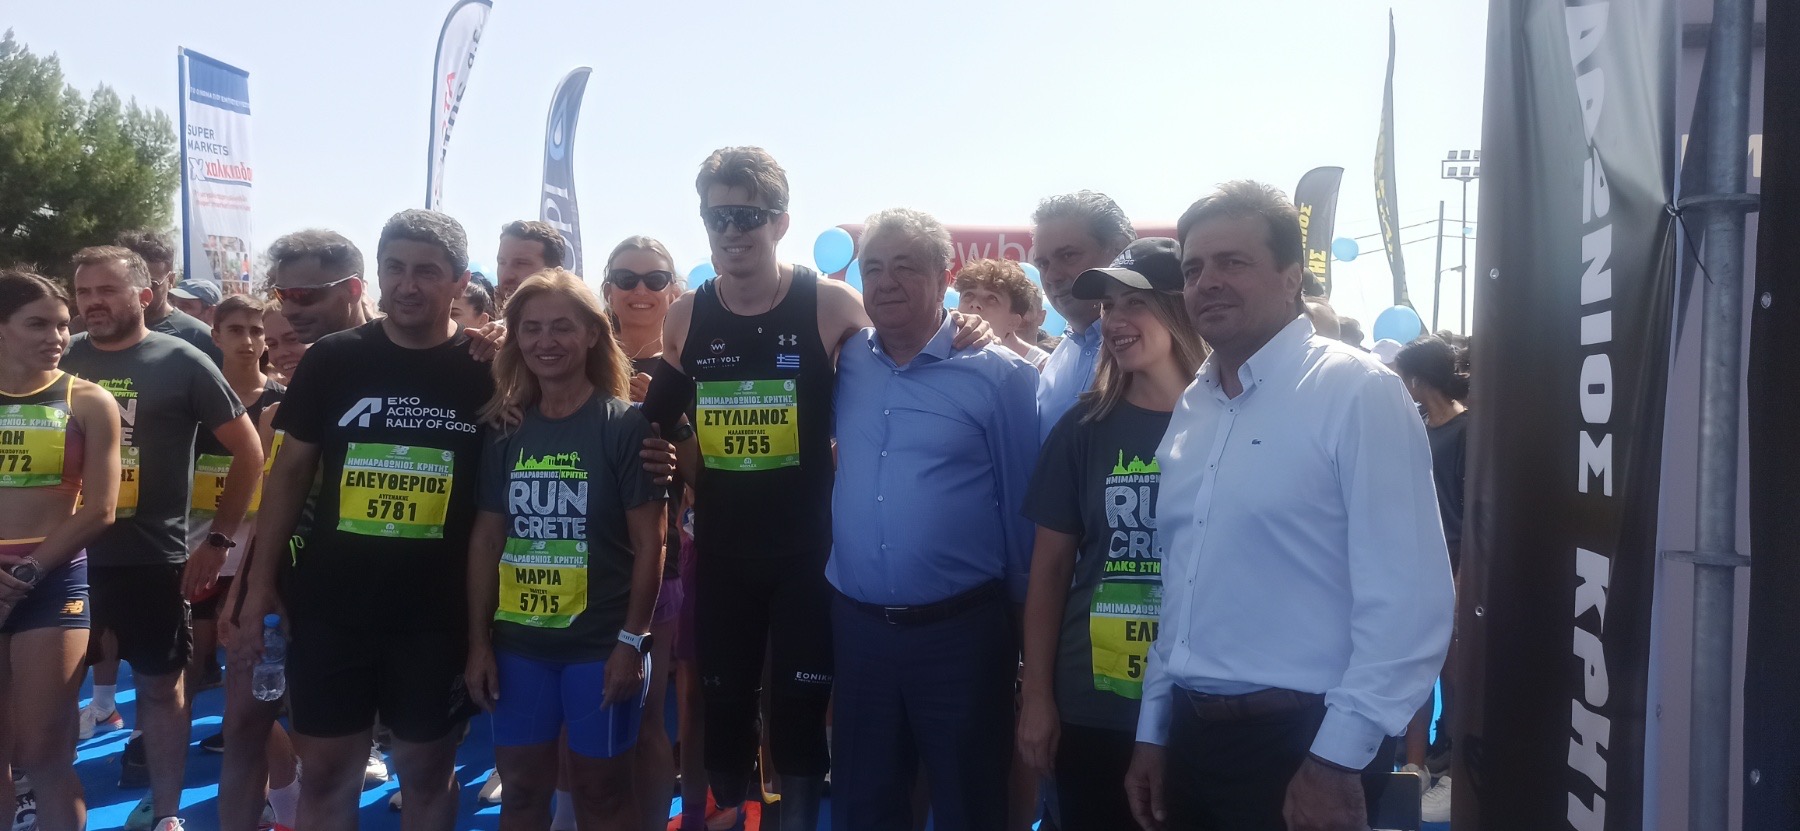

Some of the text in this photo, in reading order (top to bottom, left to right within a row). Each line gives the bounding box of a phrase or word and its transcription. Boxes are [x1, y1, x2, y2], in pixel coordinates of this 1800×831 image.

[187, 124, 215, 140] SUPER
[187, 140, 229, 156] MARKETS
[696, 358, 716, 366] WATT
[387, 397, 421, 405] EKO
[764, 395, 793, 404] ΚΡΗΤΗΣ
[386, 407, 456, 419] ACROPOLIS
[704, 408, 788, 426] ΣΤΥΛΙΑΝΟΣ
[386, 419, 477, 434] RALLY OF GODS
[0, 430, 25, 445] ΩΗ
[724, 436, 771, 455] 5755
[417, 462, 449, 473] ΚΡΗΤΗΣ
[560, 471, 588, 480] ΚΡΗΤΗΣ
[346, 471, 447, 494] ΕΛΕΥΘΕΡΙΟΣ
[508, 480, 589, 516] RUN
[366, 499, 418, 521] 5781
[514, 516, 587, 540] CRETE
[554, 556, 584, 565] ΚΡΗΤΗΣ
[515, 567, 562, 586] ΜΑΡΙΑ
[519, 593, 560, 614] 5715
